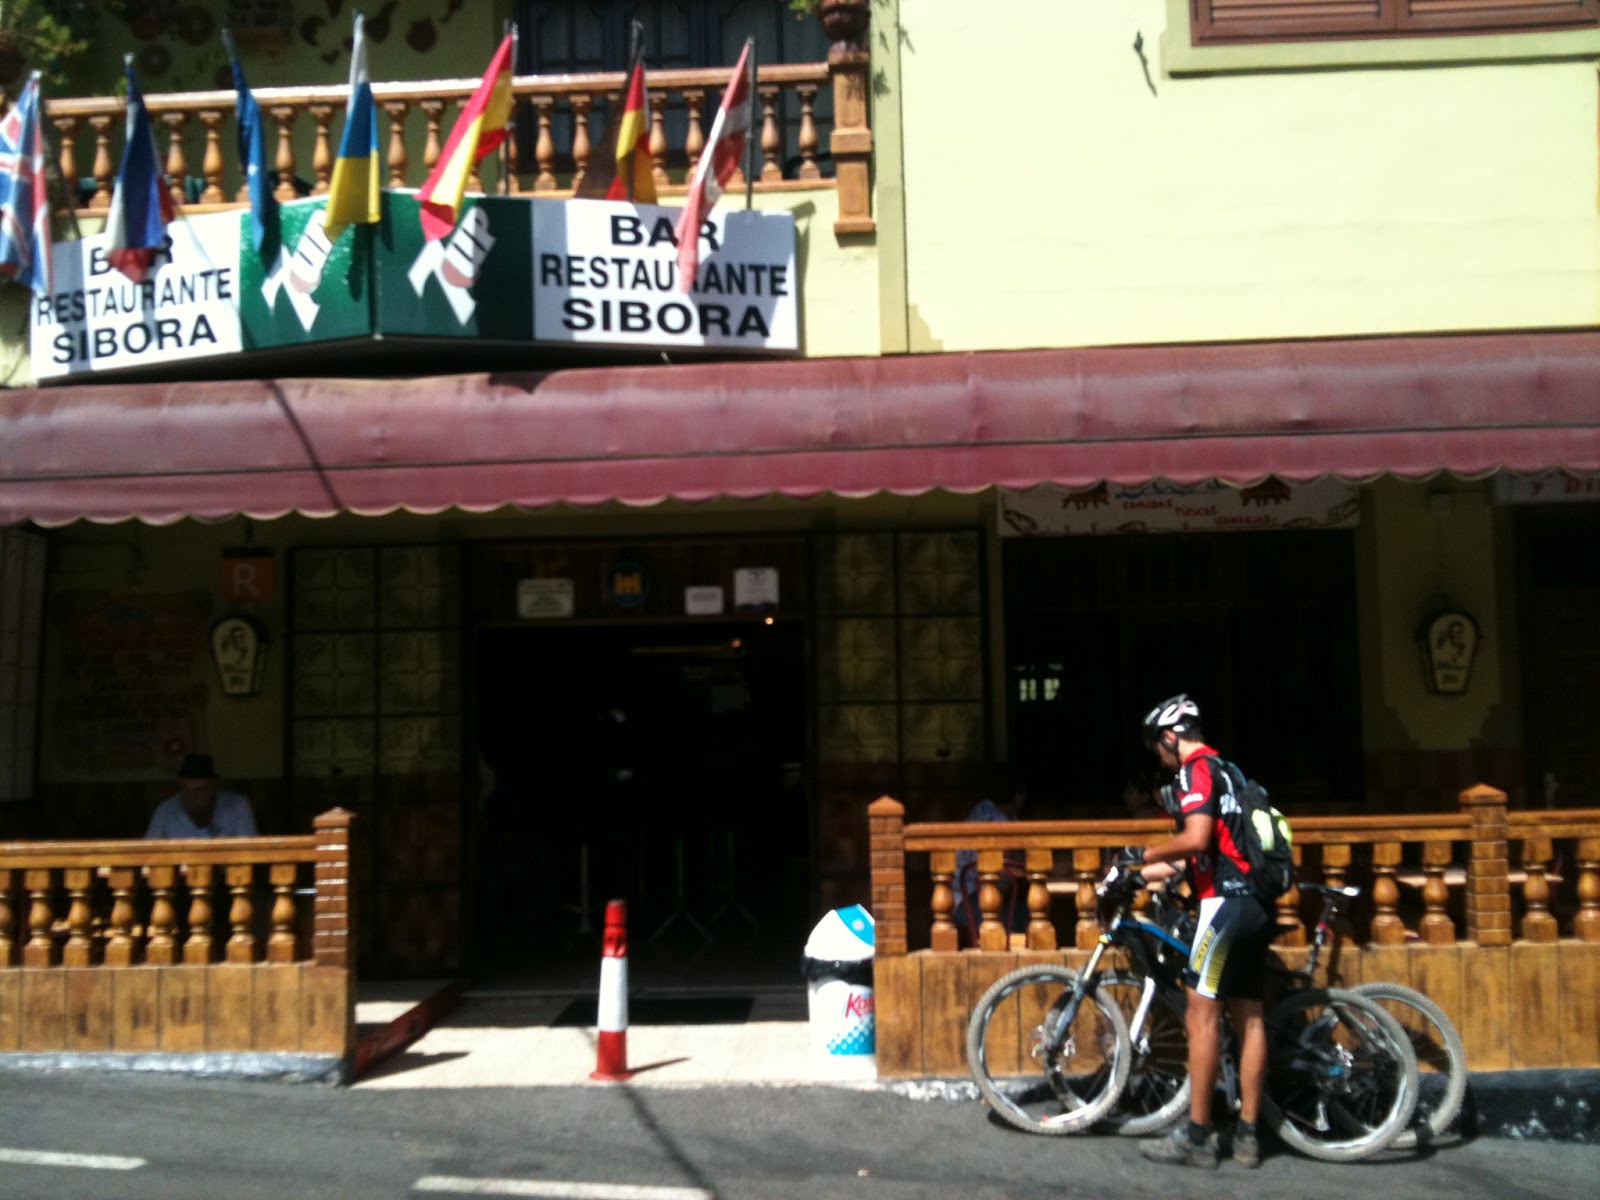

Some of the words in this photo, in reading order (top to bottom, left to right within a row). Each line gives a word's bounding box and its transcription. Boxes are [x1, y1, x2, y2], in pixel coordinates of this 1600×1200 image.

[38, 267, 232, 327] RESTAURANTE
[541, 254, 788, 297] RESTAUANTE
[53, 314, 217, 365] SIBORA
[562, 298, 770, 338] SIBORA
[233, 564, 260, 598] R
